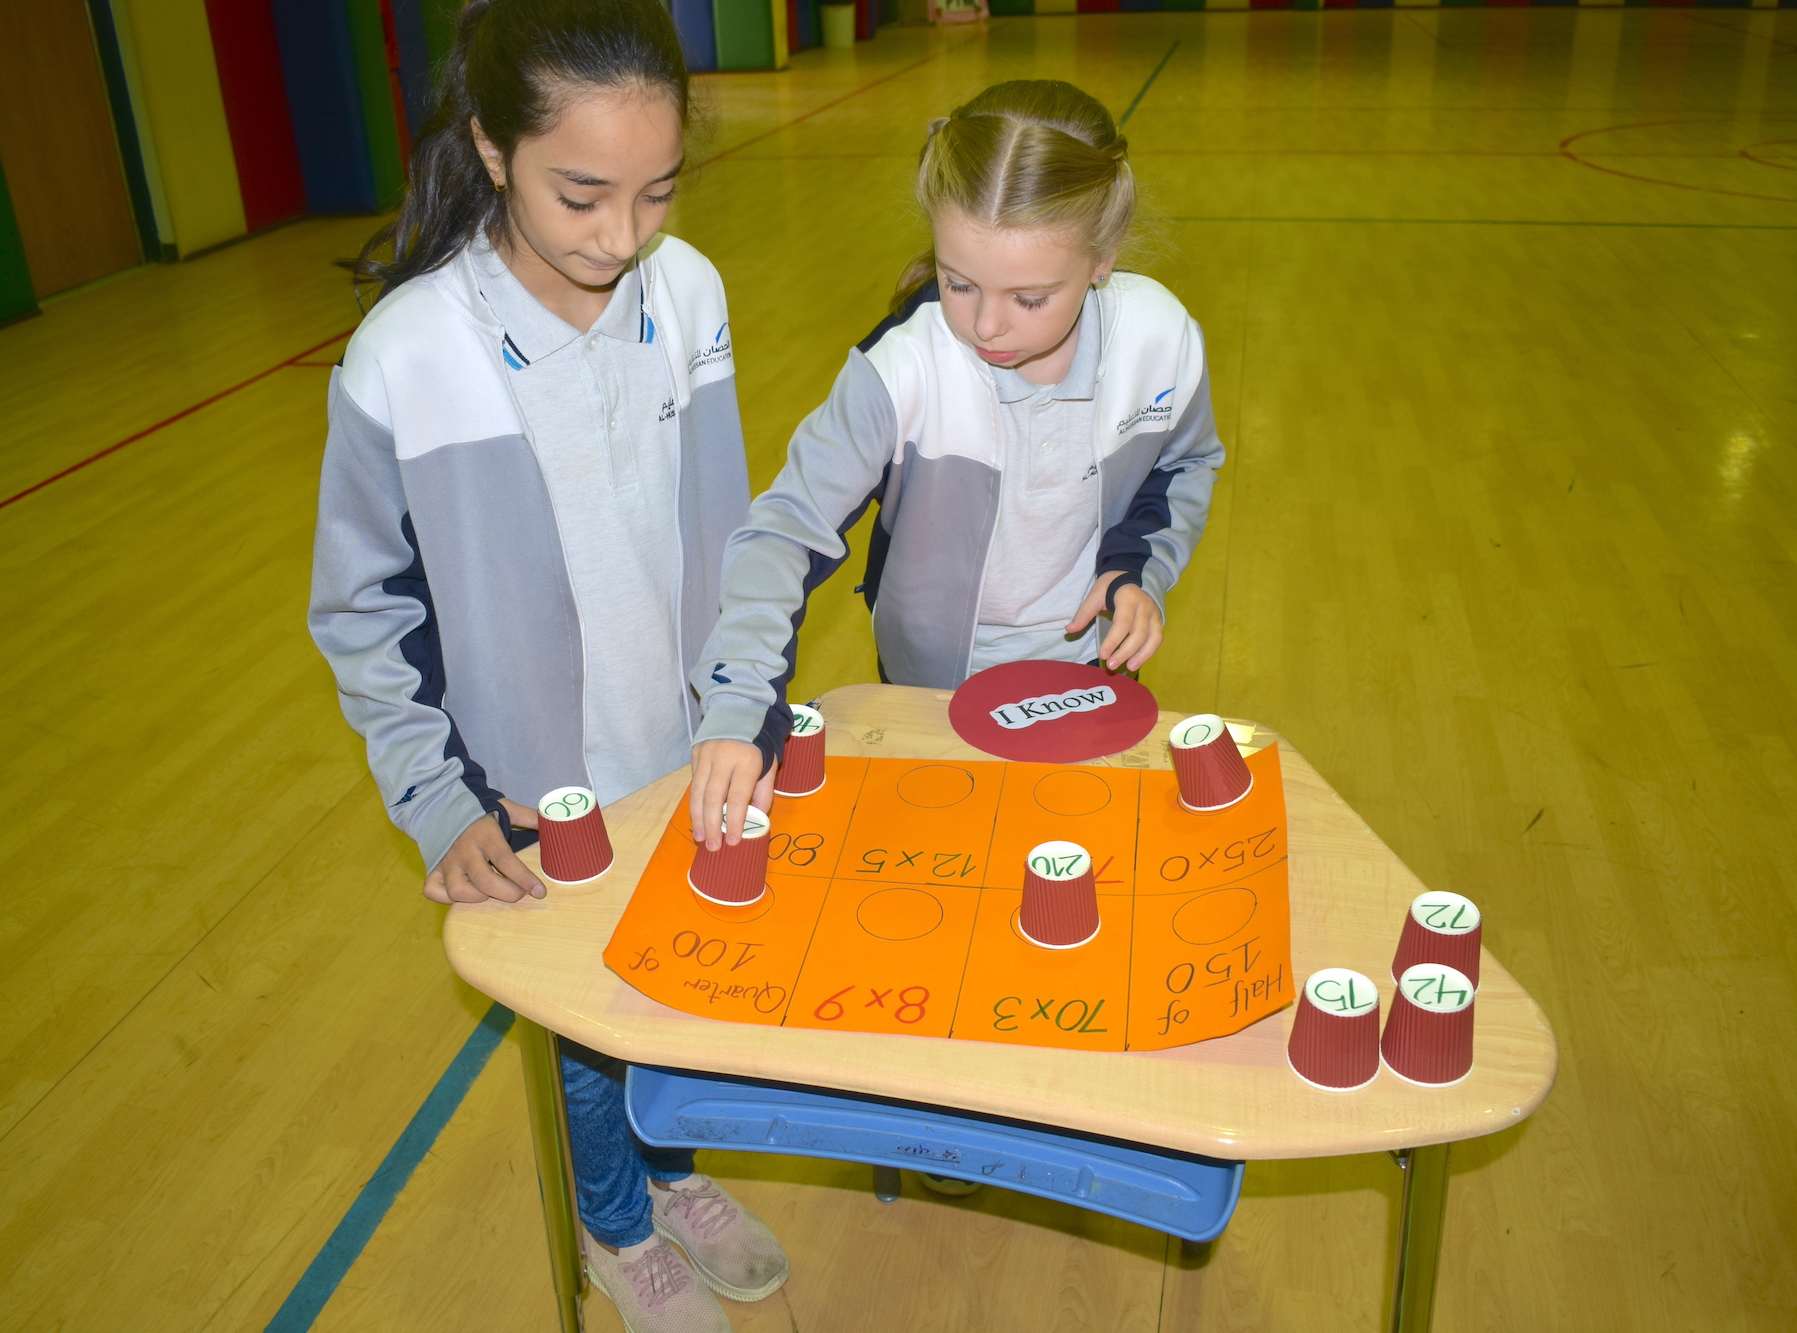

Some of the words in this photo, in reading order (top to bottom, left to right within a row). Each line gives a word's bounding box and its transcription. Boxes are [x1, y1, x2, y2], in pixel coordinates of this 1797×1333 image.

[997, 709, 1013, 725] I
[1022, 687, 1107, 723] Know
[1421, 903, 1470, 929] 72
[628, 947, 660, 972] of
[673, 930, 765, 973] 100
[1166, 937, 1262, 994] 150
[684, 980, 787, 1014] Quarter
[1230, 964, 1284, 1018] Half
[1314, 977, 1373, 1011] 75
[1407, 974, 1468, 1005] 42
[1157, 1001, 1190, 1036] of
